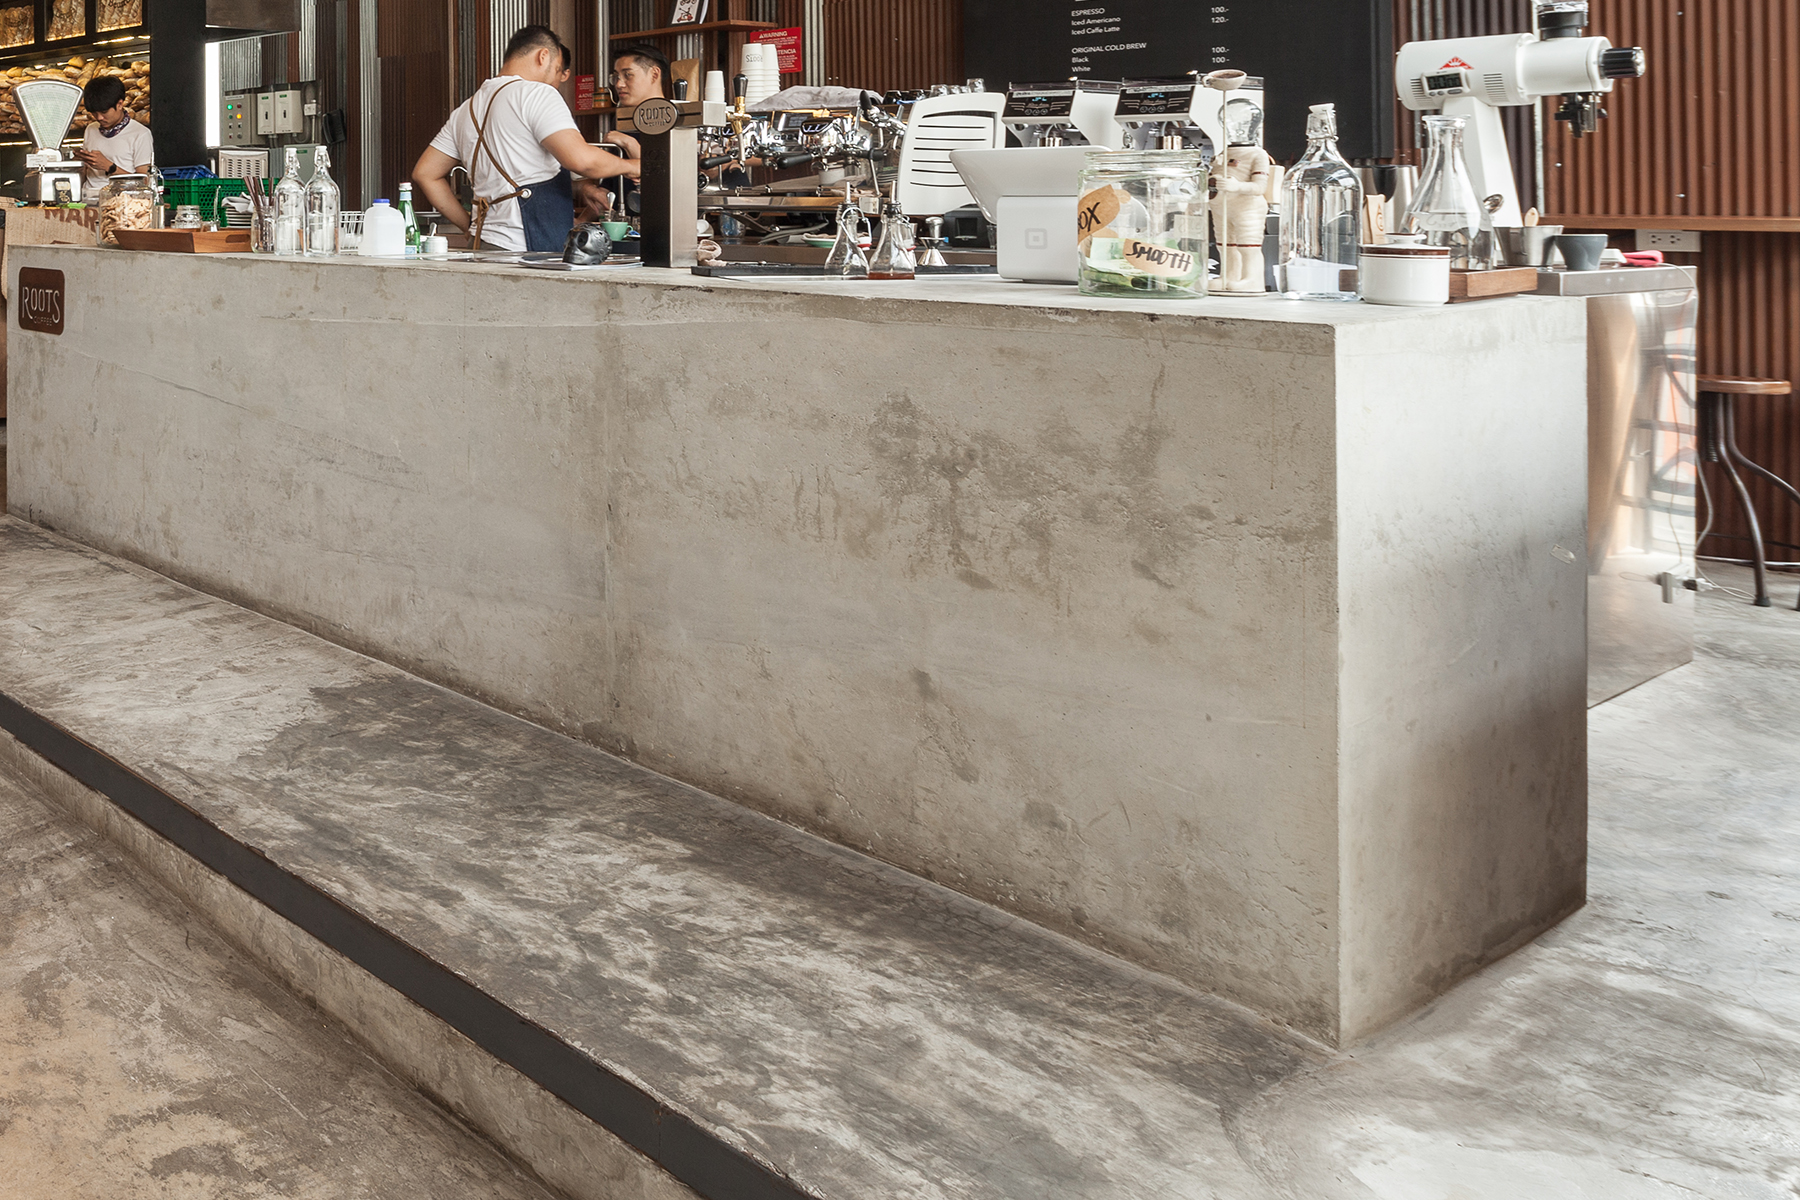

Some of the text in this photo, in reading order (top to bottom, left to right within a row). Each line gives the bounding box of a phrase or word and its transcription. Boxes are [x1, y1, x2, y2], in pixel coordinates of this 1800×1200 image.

[1071, 7, 1106, 17] ESPRESSO
[1086, 16, 1121, 25] Americano
[1071, 42, 1147, 54] ORIGINAL COLD BREW
[1071, 65, 1091, 73] White
[638, 106, 672, 125] ROOTS
[1077, 202, 1101, 232] OX
[1125, 242, 1191, 272] SMOOTH
[22, 287, 61, 324] ROOTS
[32, 315, 53, 327] COFFEE
